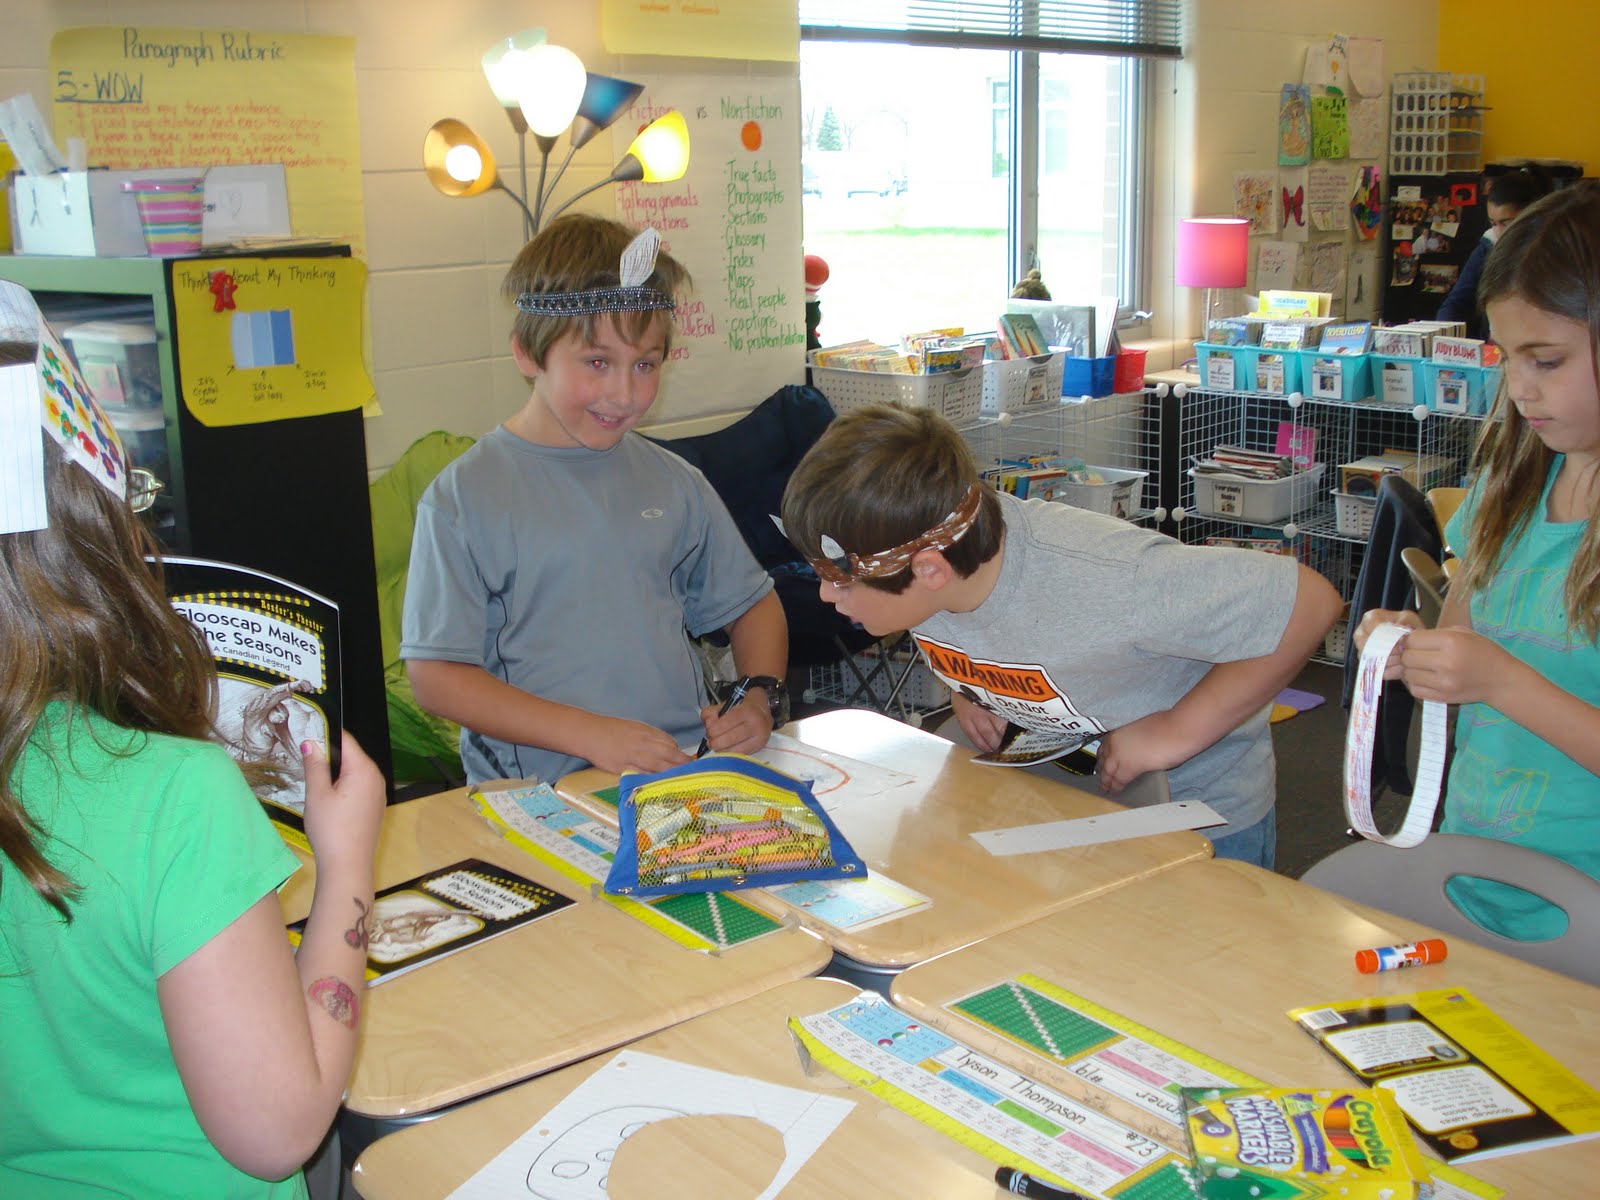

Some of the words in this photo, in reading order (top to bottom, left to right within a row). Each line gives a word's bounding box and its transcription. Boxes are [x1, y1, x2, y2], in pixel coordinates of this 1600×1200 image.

[123, 27, 214, 68] Paragraph
[221, 32, 284, 62] Rubric
[720, 95, 783, 120] Nonfiction
[727, 160, 749, 183] True
[727, 183, 785, 211] Photographs
[727, 203, 768, 226] Sections
[725, 224, 766, 252] Glossary
[727, 246, 754, 269] Index
[267, 268, 282, 287] My
[288, 265, 337, 288] Thinking
[727, 266, 756, 295] Maps
[1326, 326, 1348, 337] BEVERLY
[1347, 325, 1367, 336] CLEARY
[1434, 341, 1453, 357] JUDY
[1453, 344, 1477, 360] BLUME
[260, 599, 295, 620] Reader's
[202, 626, 228, 644] he
[233, 631, 303, 666] Seasons
[268, 623, 318, 656] Makes
[222, 645, 261, 662] Canadian
[262, 655, 291, 672] Legend
[943, 652, 1045, 697] WARNING
[995, 697, 1018, 709] Do
[1017, 701, 1050, 715] Not
[1061, 720, 1082, 731] In
[955, 1049, 999, 1081] Tyson
[1008, 1075, 1087, 1126] Thompson
[1124, 1130, 1160, 1158] #23
[1205, 1123, 1226, 1135] 8
[1225, 1097, 1271, 1166] MARKERS
[1249, 1096, 1295, 1166] WASHABLE
[1349, 1099, 1393, 1169] Crayola
